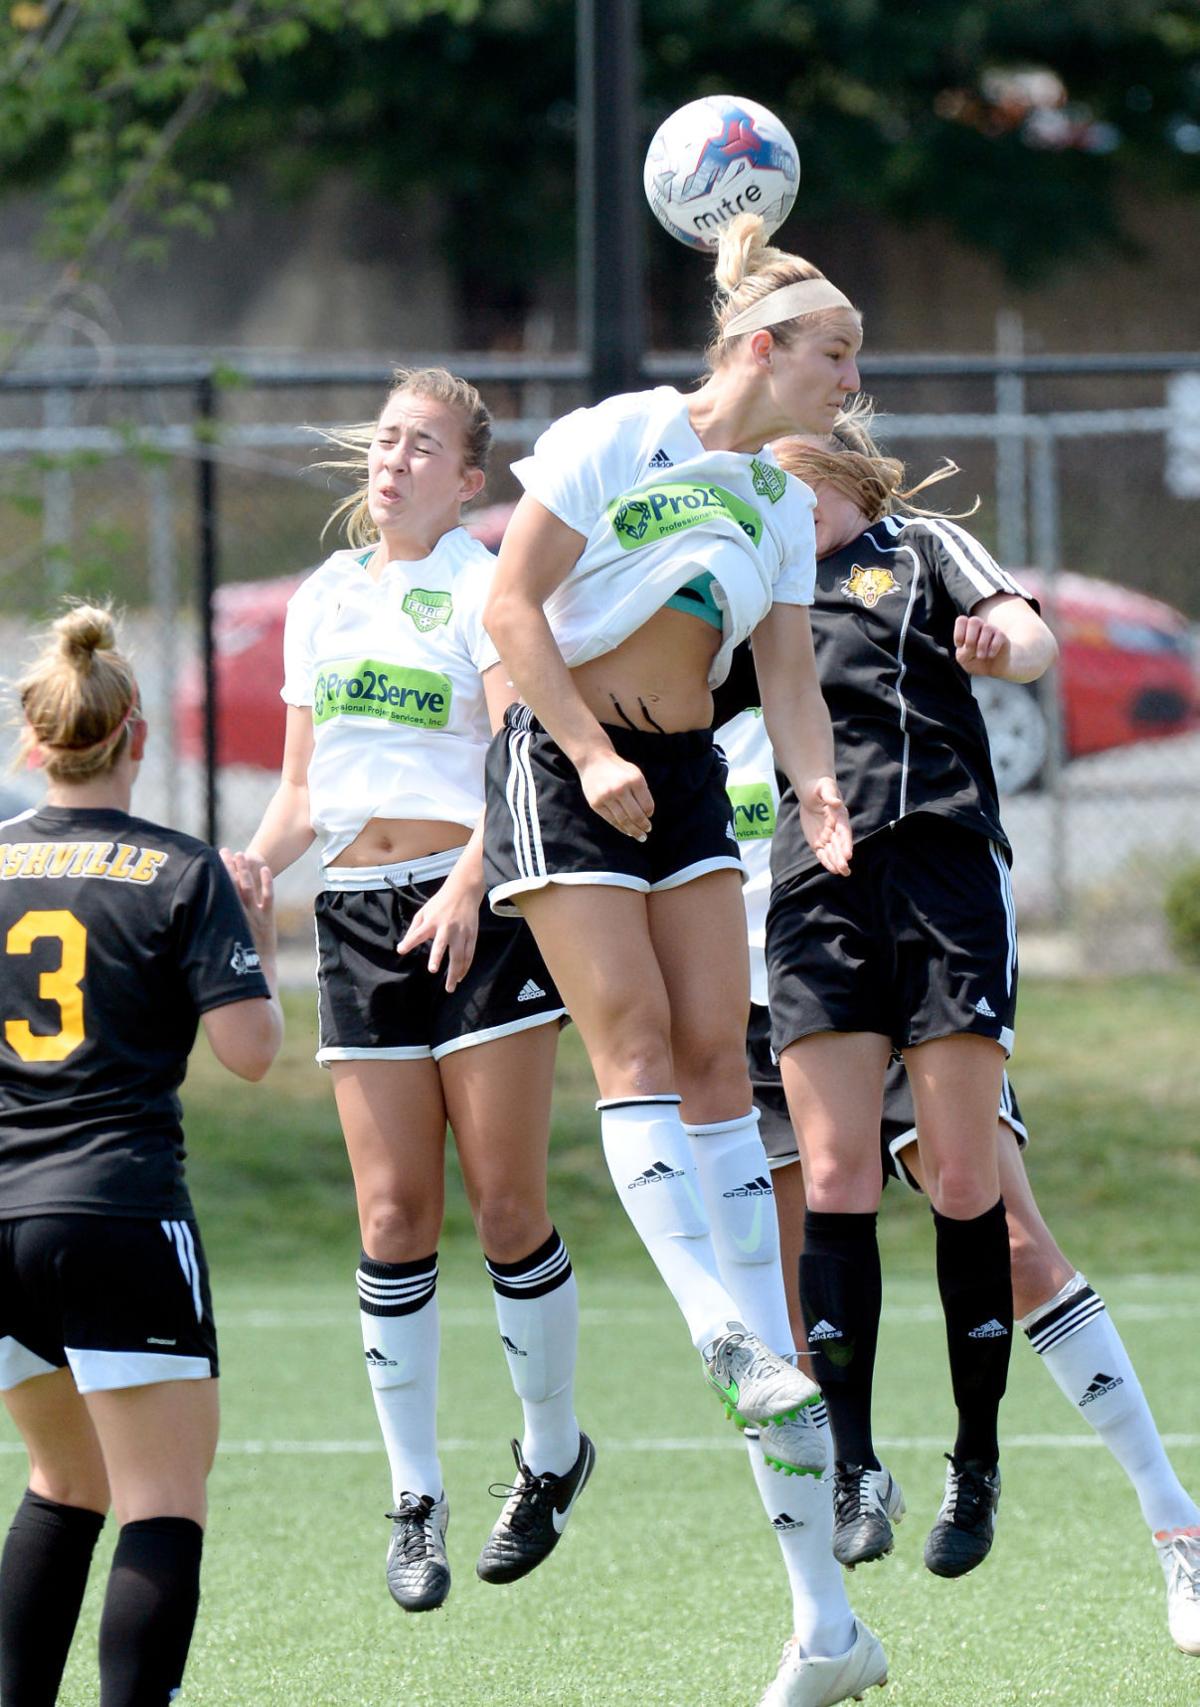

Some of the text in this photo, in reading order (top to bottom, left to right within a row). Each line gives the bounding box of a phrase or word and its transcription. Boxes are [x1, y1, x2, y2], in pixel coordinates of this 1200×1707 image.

[693, 183, 762, 231] mitre
[327, 670, 444, 713] Pro2Serve
[4, 910, 87, 1062] 3
[628, 1170, 685, 1190] adidas
[807, 1329, 843, 1343] adidas
[968, 1327, 1008, 1338] adidas
[1078, 1376, 1124, 1407] adidas
